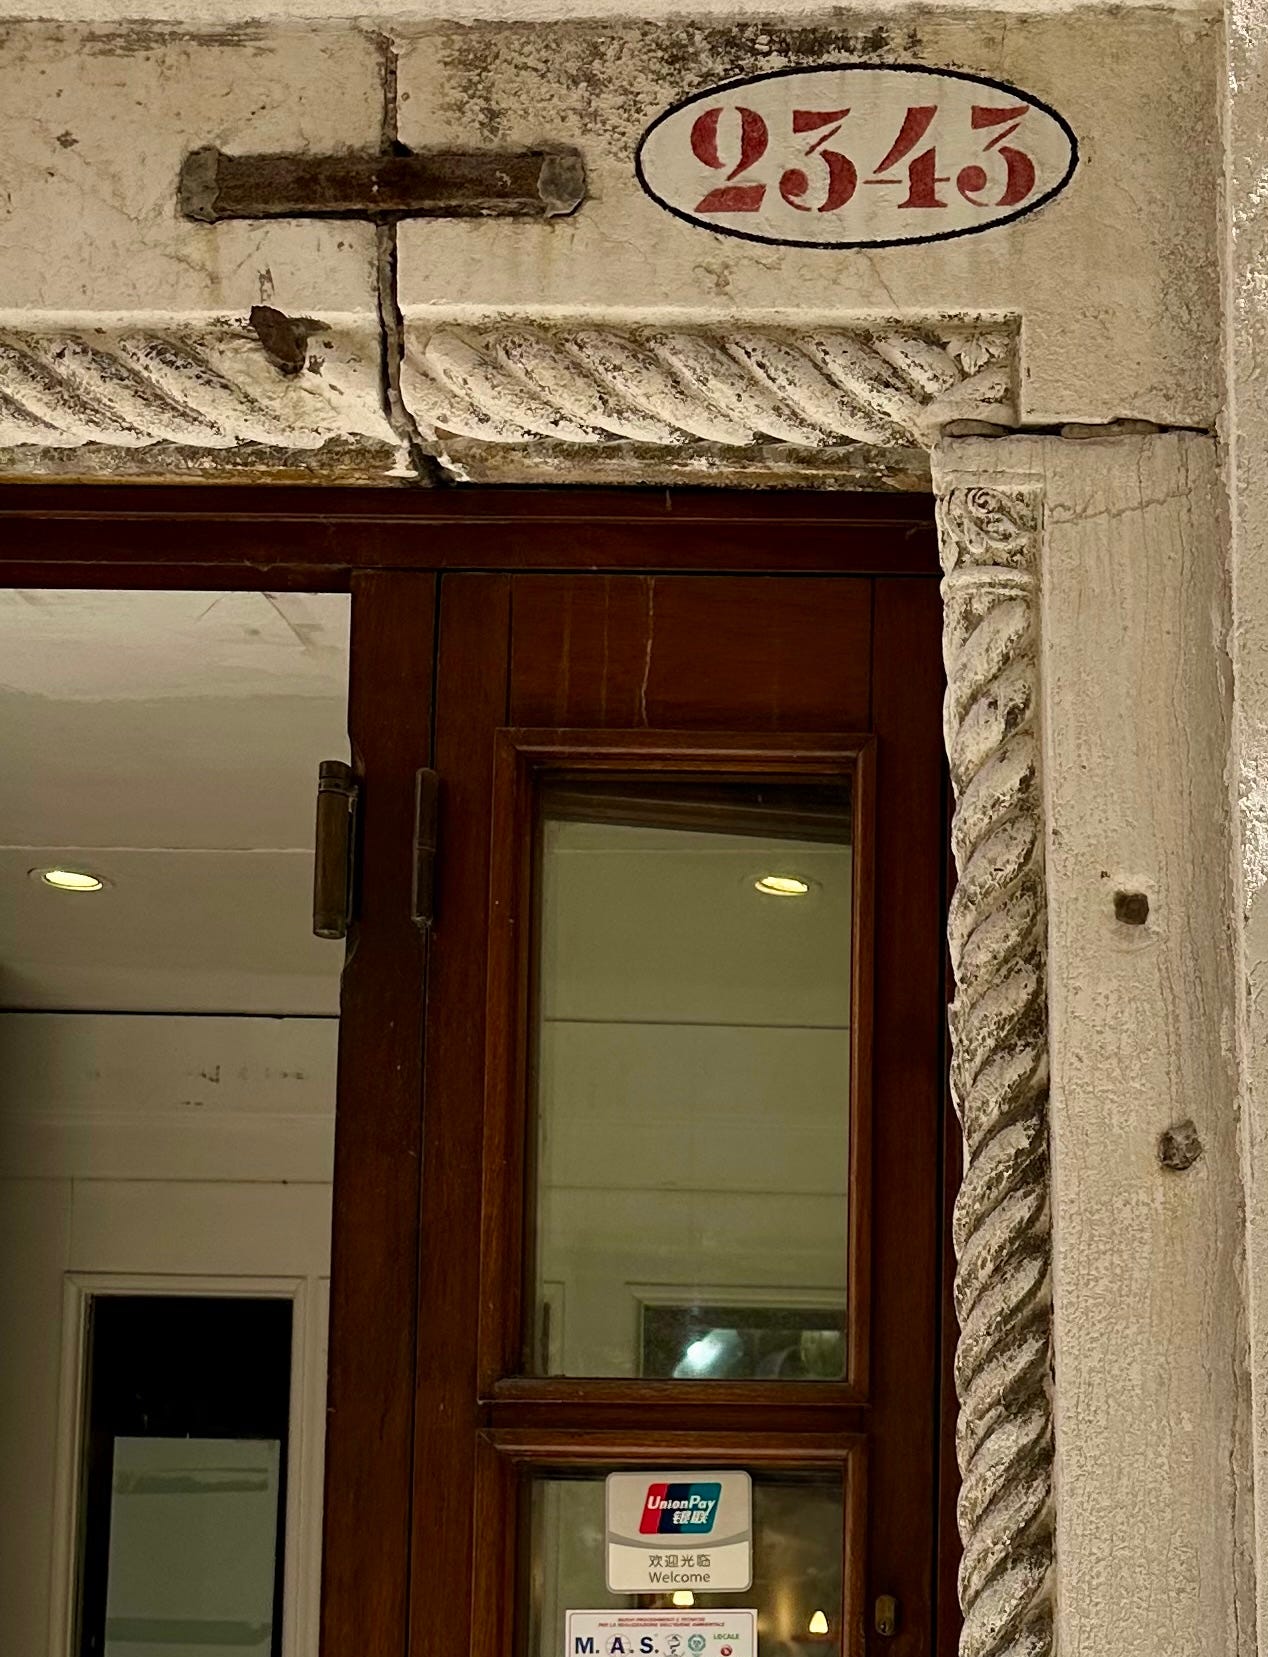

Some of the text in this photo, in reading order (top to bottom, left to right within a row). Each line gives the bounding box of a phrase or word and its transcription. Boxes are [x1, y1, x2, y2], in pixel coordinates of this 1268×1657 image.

[690, 105, 1036, 213] 2343
[647, 1496, 716, 1516] UnionPay
[649, 1554, 711, 1568] 欢迎光临
[649, 1572, 710, 1583] Welcome
